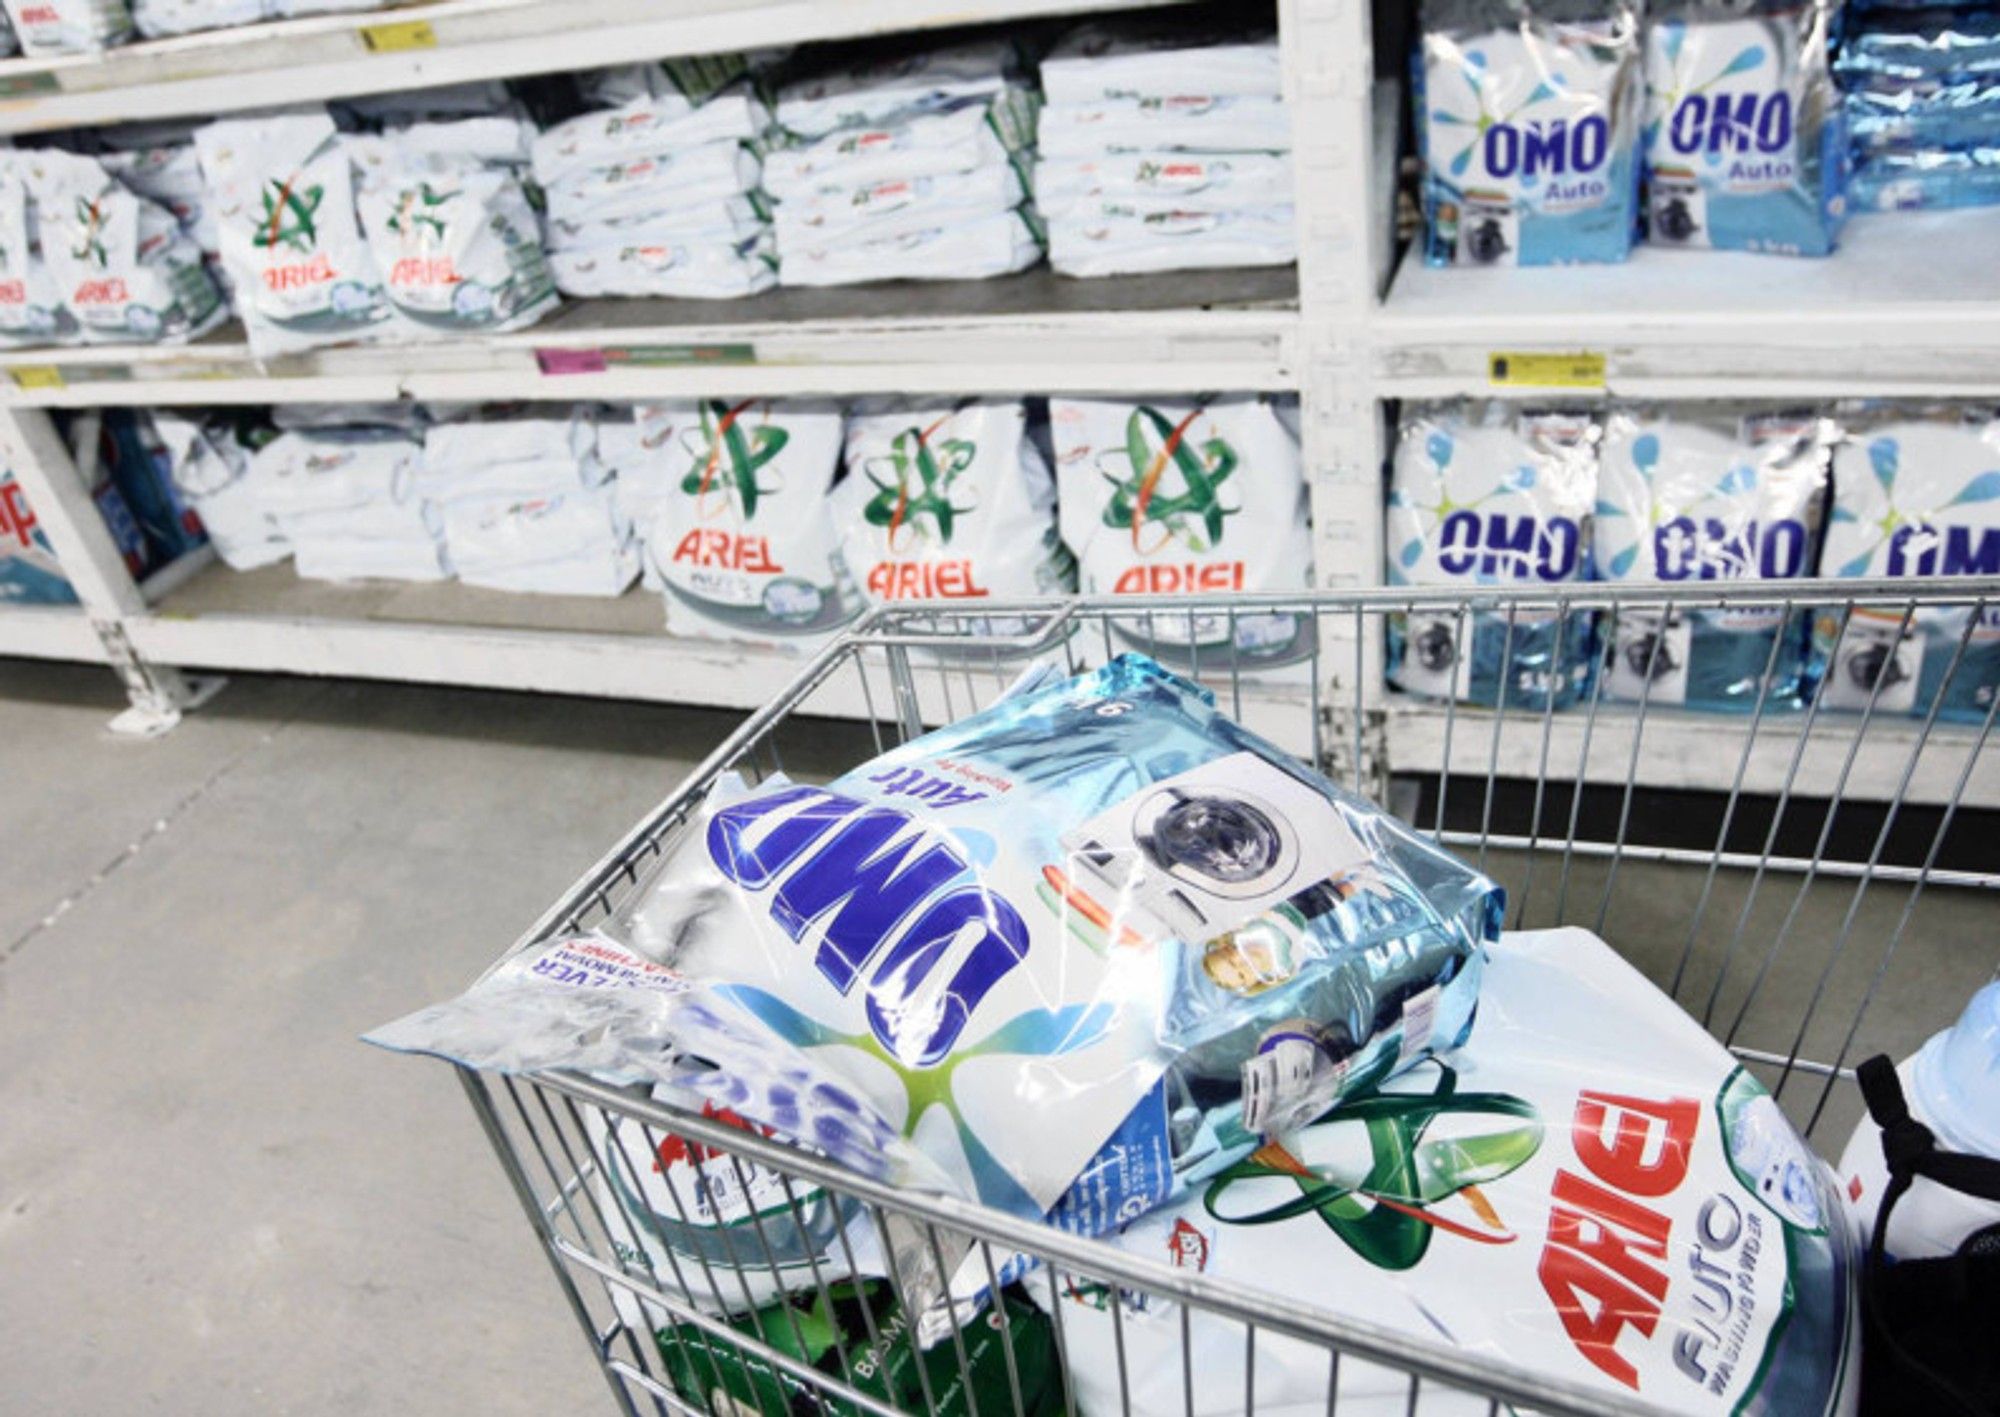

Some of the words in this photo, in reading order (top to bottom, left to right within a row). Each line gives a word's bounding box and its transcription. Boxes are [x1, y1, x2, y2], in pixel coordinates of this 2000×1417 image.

[1485, 114, 1607, 179] OMO
[1670, 90, 1792, 155] OMO
[1545, 181, 1605, 200] Auto
[1729, 160, 1792, 180] Auto
[1439, 510, 1579, 582] OMO
[1655, 516, 1806, 581] OMO
[867, 560, 989, 599] ARIEL
[706, 783, 1030, 1067] OMO
[1537, 1089, 1700, 1391] ARIEL
